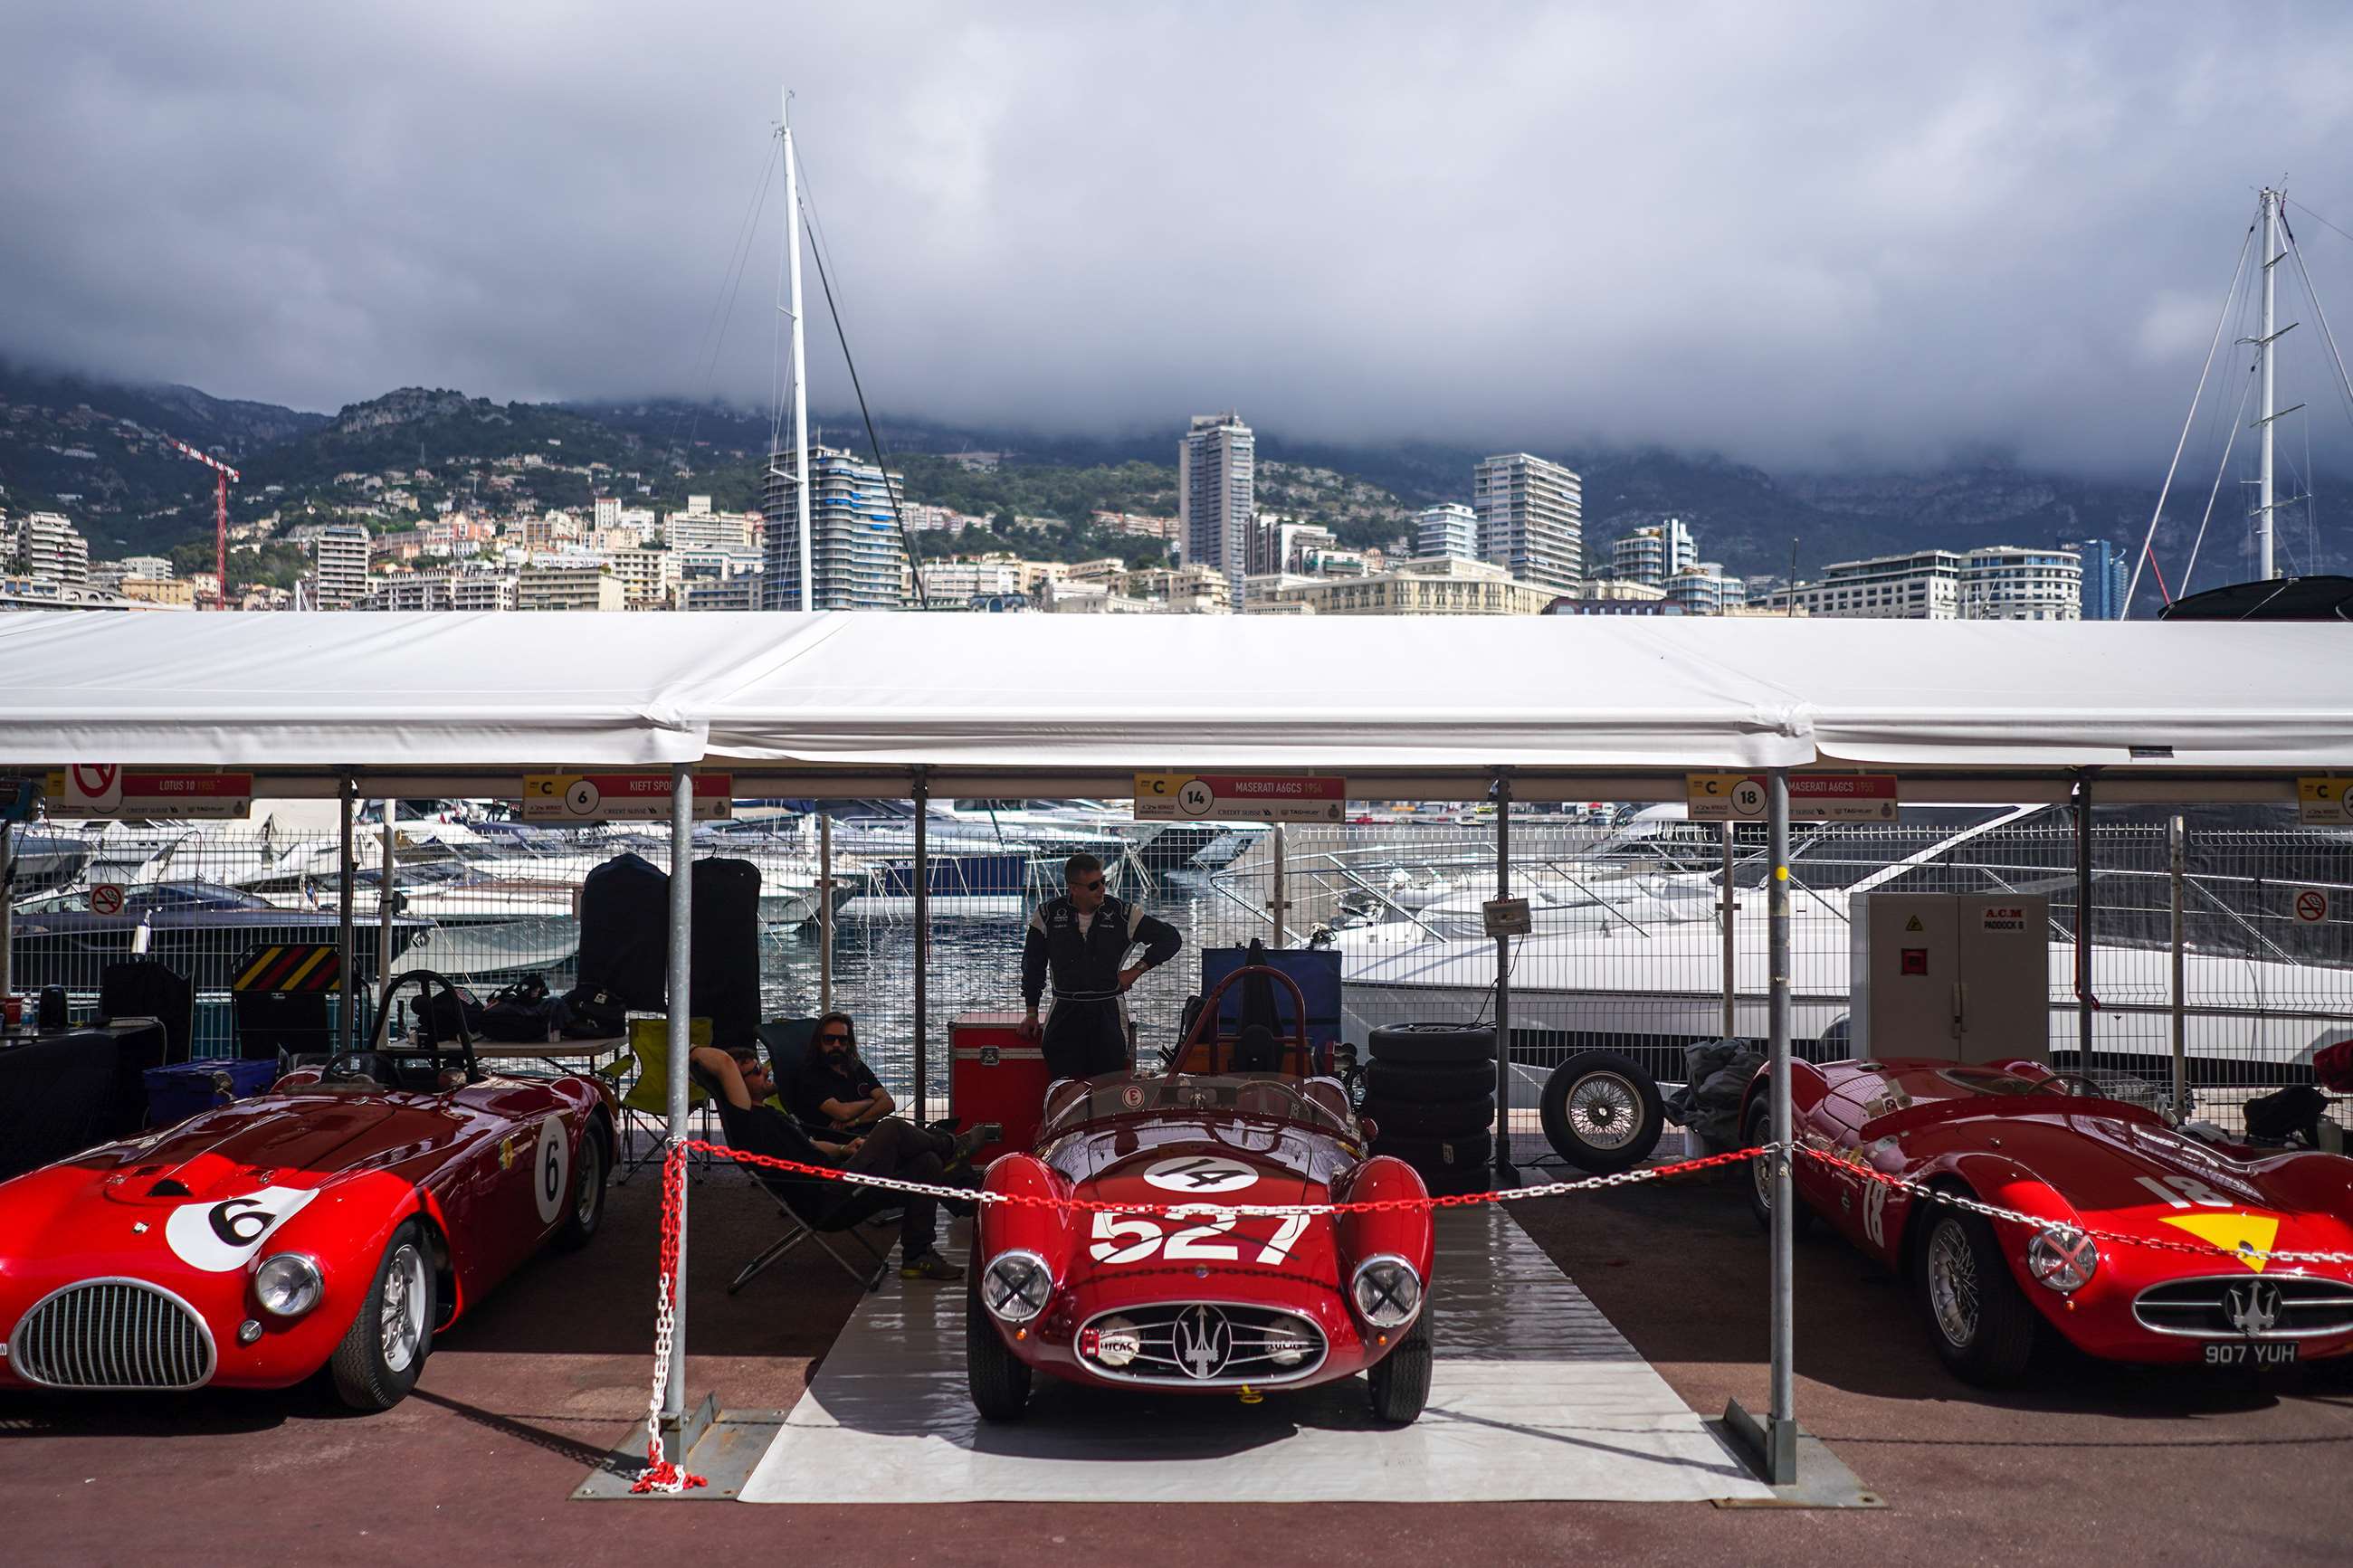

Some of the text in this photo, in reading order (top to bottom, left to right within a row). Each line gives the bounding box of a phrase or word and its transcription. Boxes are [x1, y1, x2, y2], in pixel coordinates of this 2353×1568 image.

[159, 780, 184, 791] LOTUS
[186, 780, 195, 791] 10
[541, 782, 553, 794] C
[630, 781, 652, 792] KIEFT
[1153, 781, 1165, 794] C
[1235, 782, 1274, 793] MASERATI
[1276, 783, 1302, 794] A6GCS
[1706, 781, 1718, 794] C
[1788, 782, 1826, 793] MASERATI
[1828, 782, 1854, 793] A6GCS
[2317, 784, 2329, 797] C
[578, 791, 587, 803] 6
[1187, 791, 1205, 804] 14
[1740, 791, 1757, 803] 18
[1984, 921, 2016, 929] PADDOCK
[1129, 1090, 1138, 1101] E
[546, 1137, 558, 1202] 6
[1155, 1158, 1249, 1189] 14
[2134, 1175, 2234, 1209] 18
[1862, 1177, 1887, 1249] 18
[208, 1199, 277, 1248] 6
[1089, 1202, 1311, 1266] 527
[2205, 1345, 2296, 1364] 907 YUH
